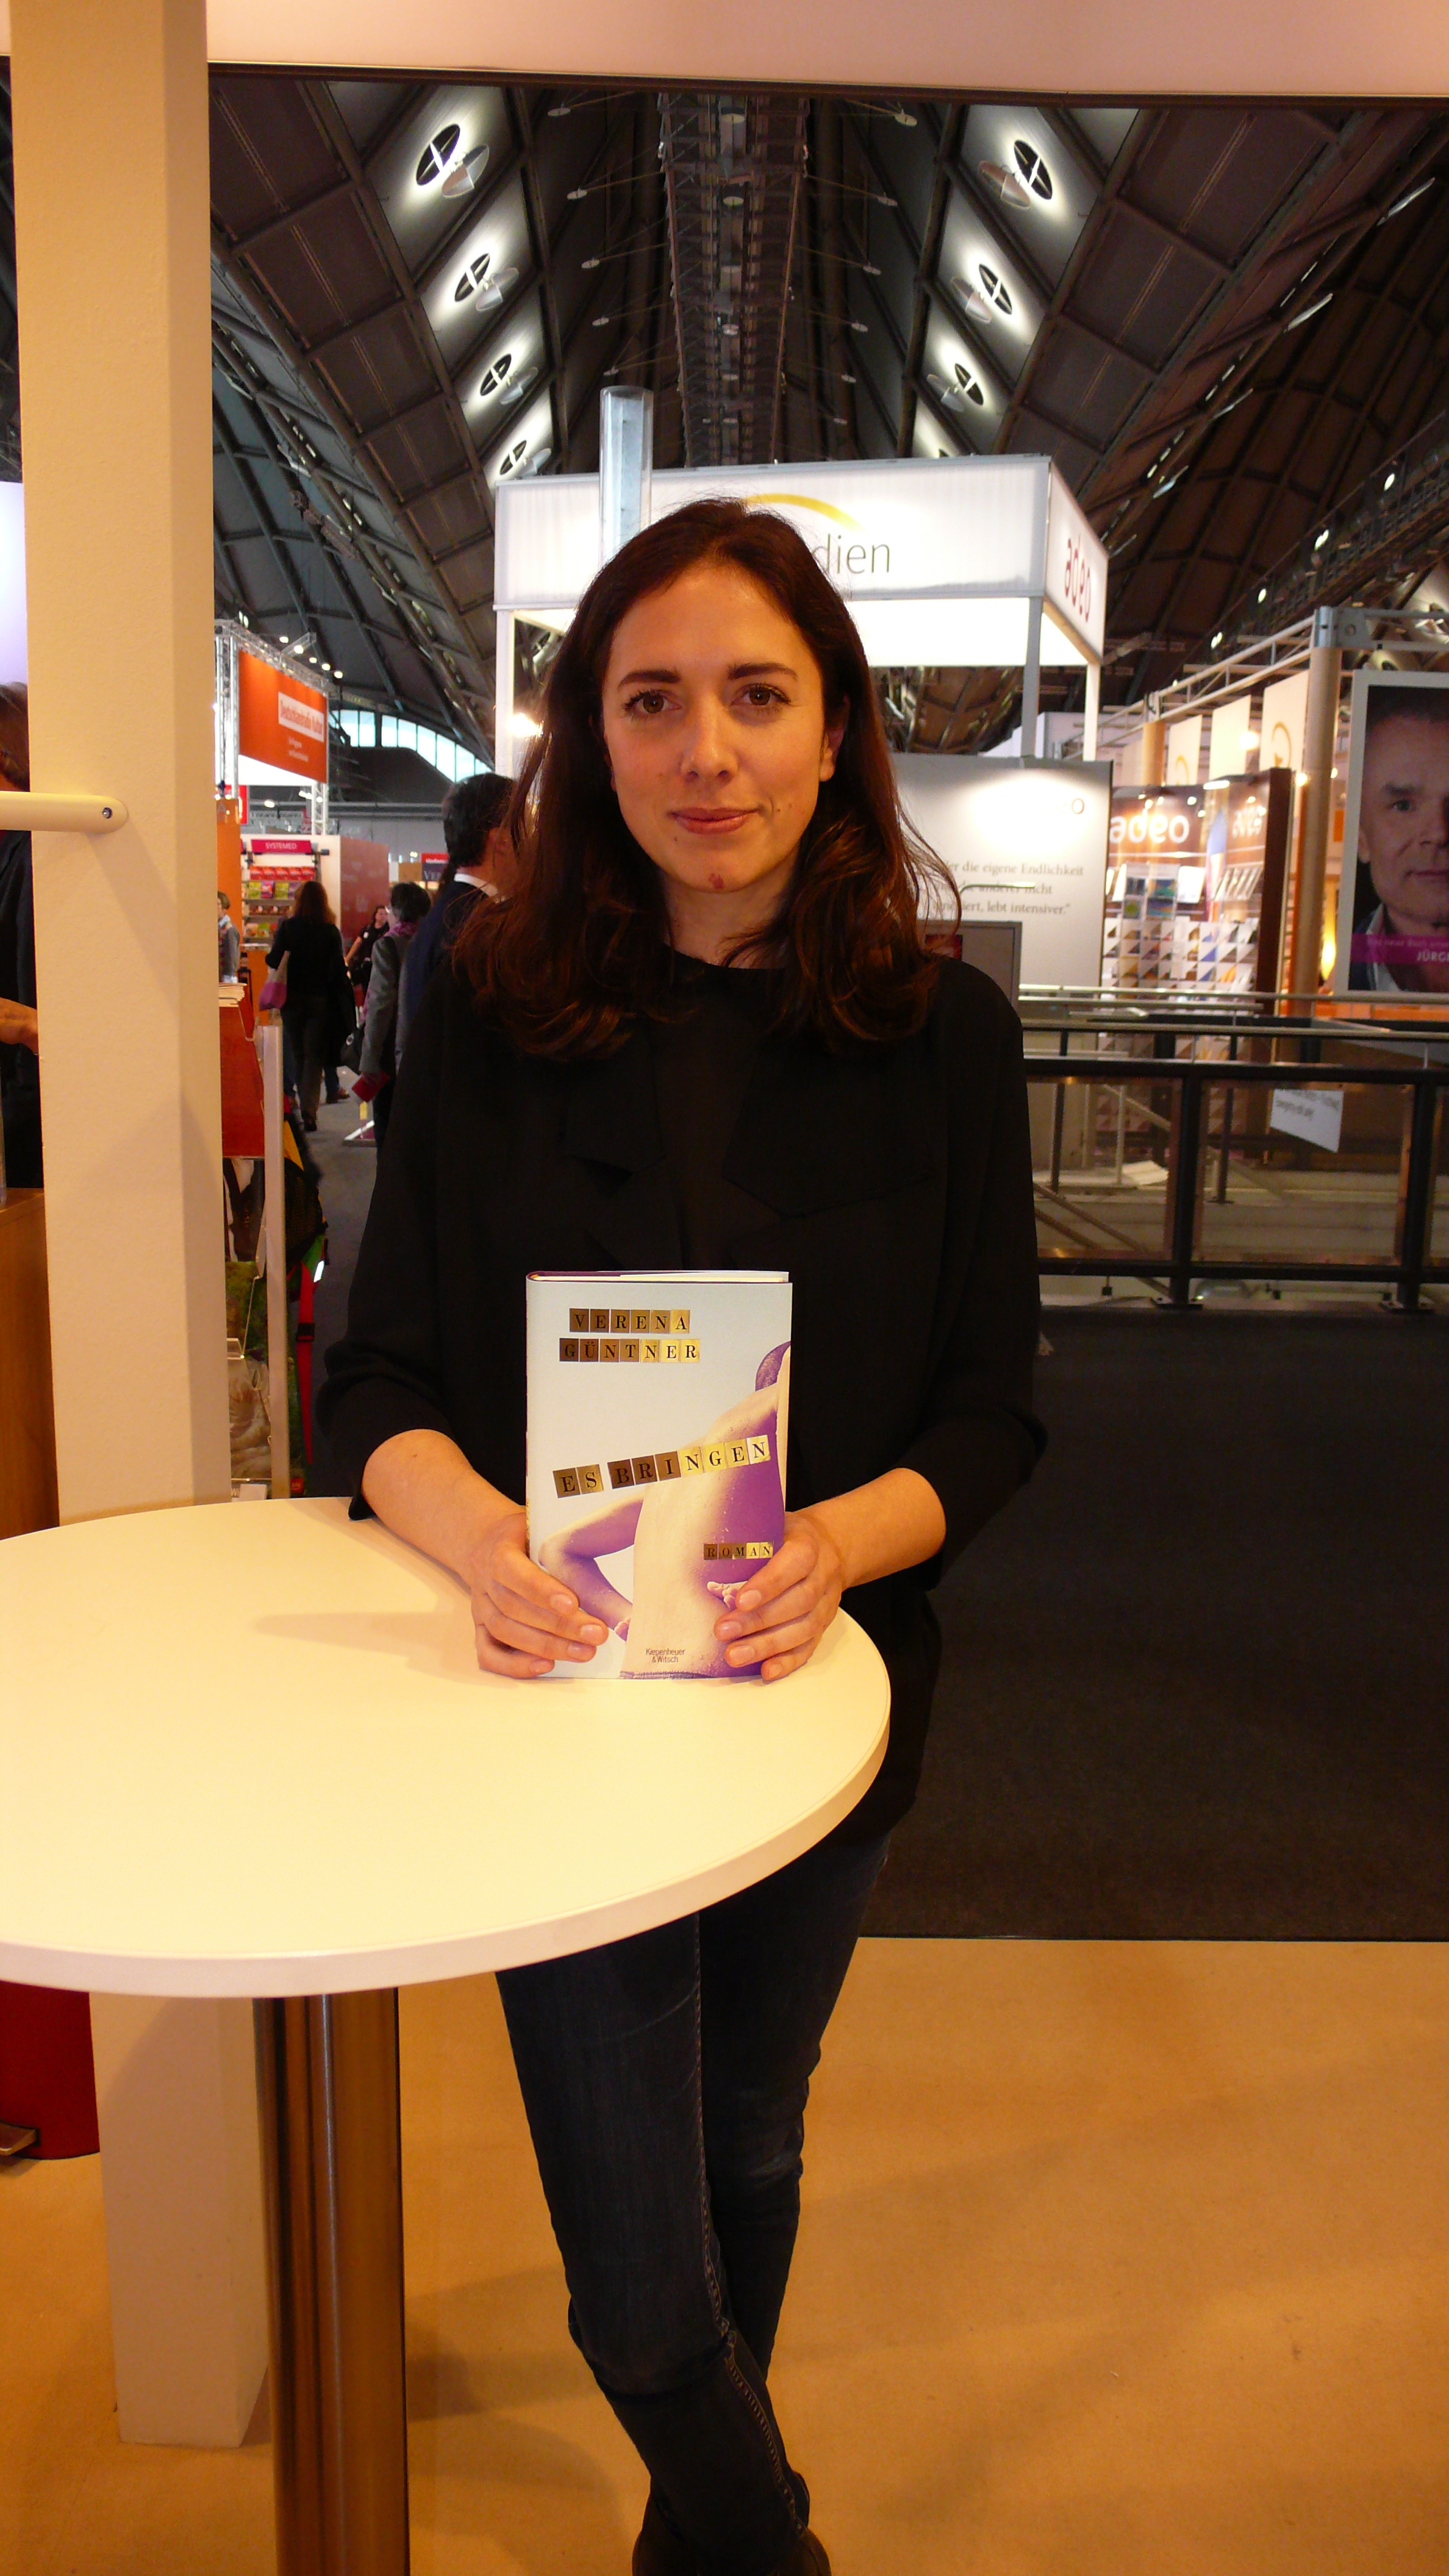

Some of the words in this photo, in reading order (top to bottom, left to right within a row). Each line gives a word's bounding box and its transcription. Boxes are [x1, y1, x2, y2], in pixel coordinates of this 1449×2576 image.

[1064, 534, 1091, 623] adeo
[1109, 807, 1190, 844] adeo
[962, 860, 979, 872] die
[982, 862, 1017, 876] eigene
[1021, 862, 1084, 876] Endlichkeit
[987, 900, 1007, 913] lebt
[574, 1312, 689, 1331] VERENA
[564, 1341, 698, 1360] GÜNTNER
[560, 1470, 599, 1494] ES
[616, 1440, 770, 1487] BRINGEN
[706, 1544, 773, 1558] ROMAN
